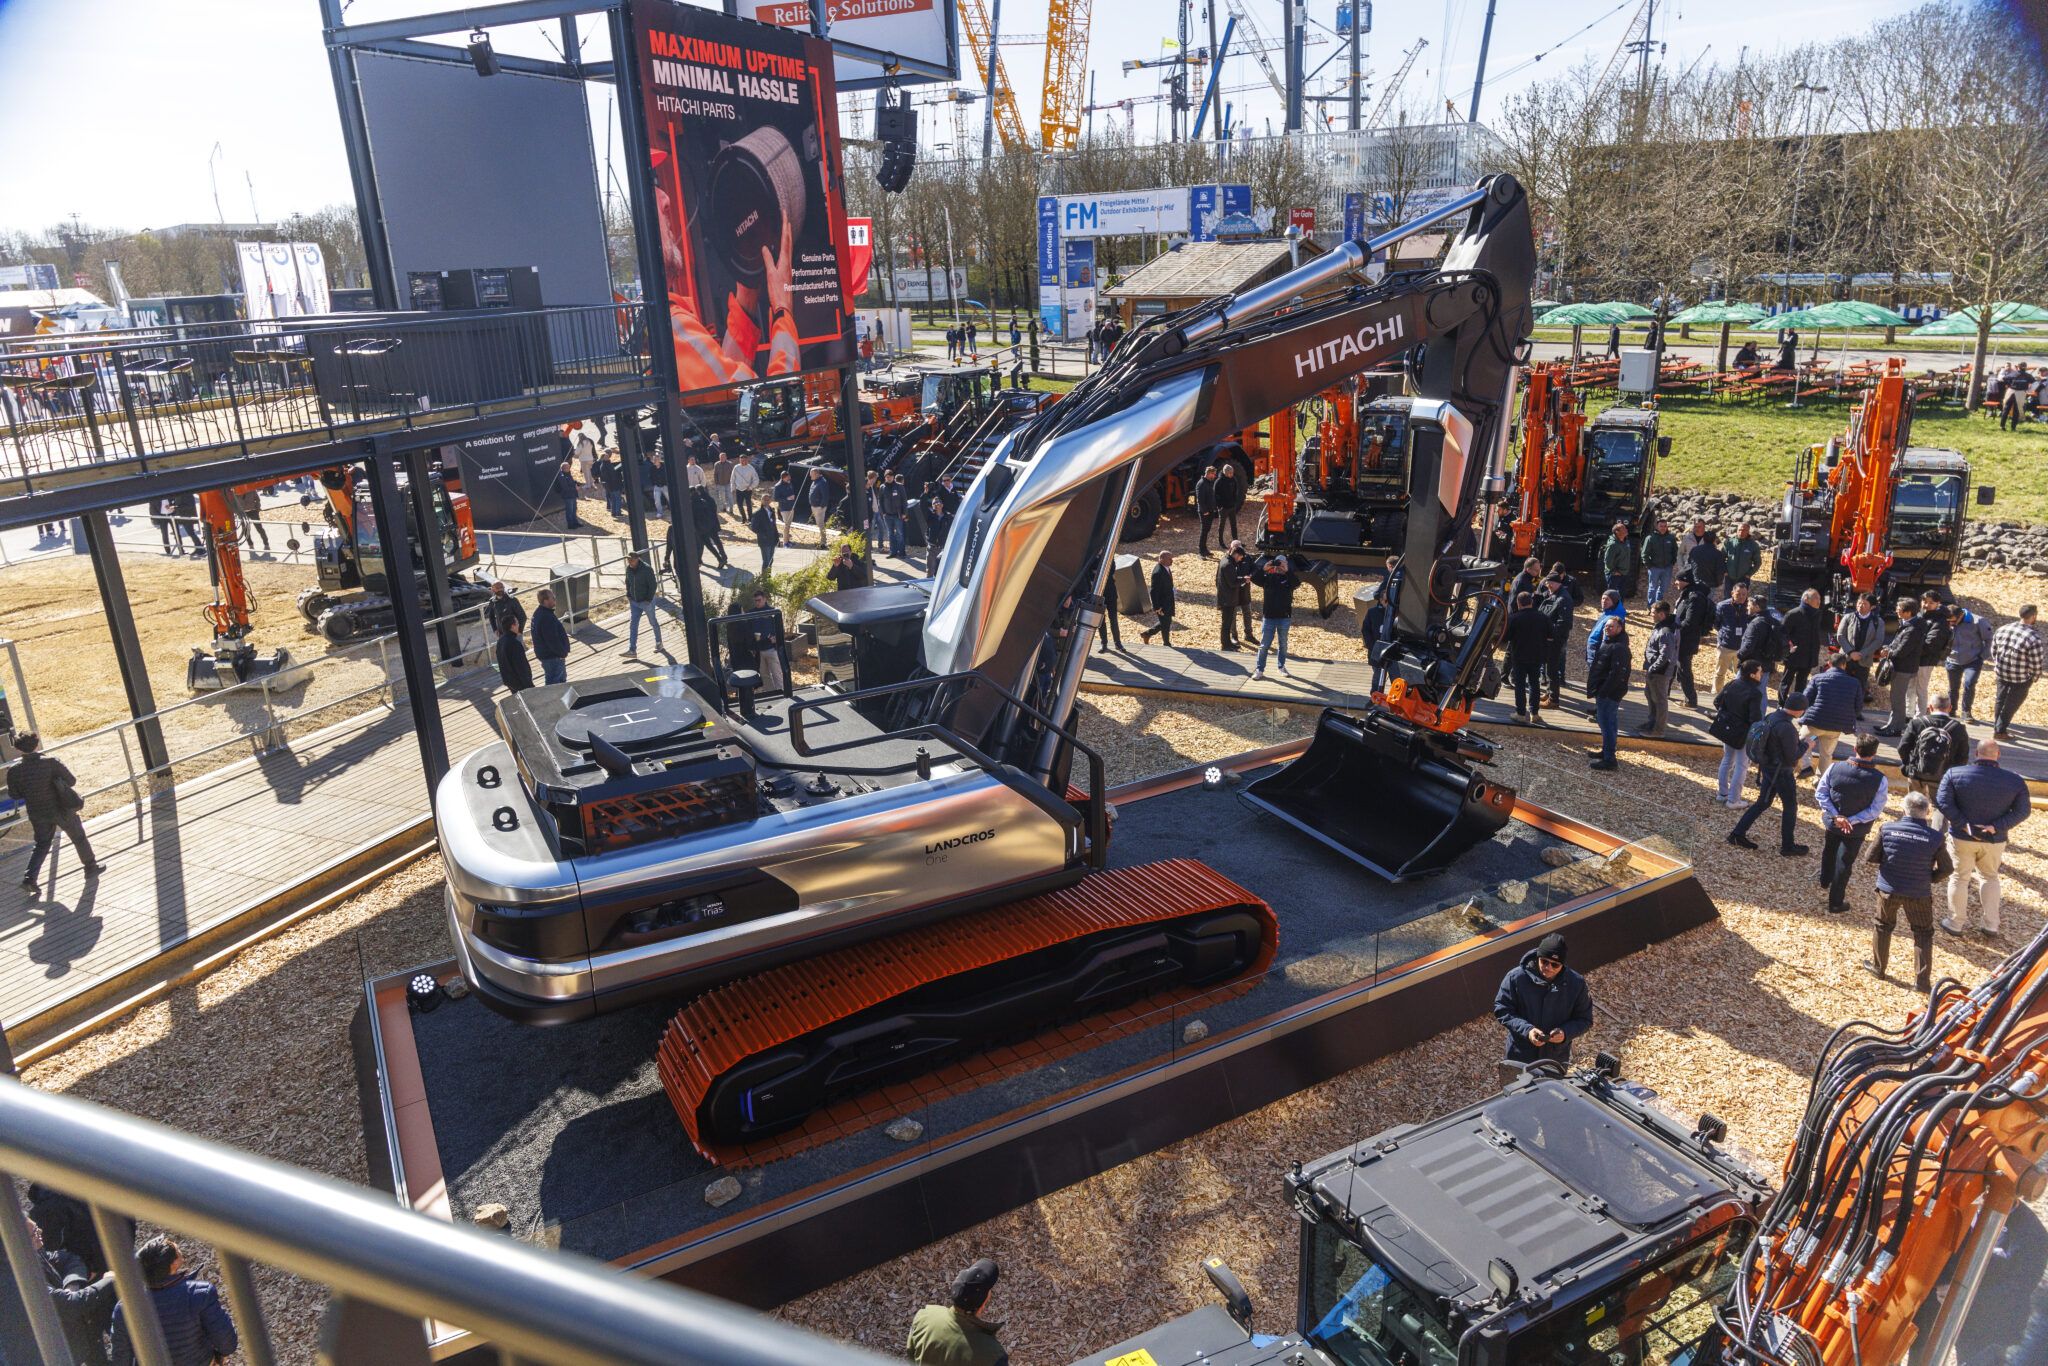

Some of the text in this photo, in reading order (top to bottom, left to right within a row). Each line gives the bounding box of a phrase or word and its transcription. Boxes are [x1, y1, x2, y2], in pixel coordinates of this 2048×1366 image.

[774, 0, 915, 24] Reliae Solutions
[649, 29, 806, 80] MAXIMUM UPTIME
[652, 59, 799, 104] MINIMAL HASSLE
[656, 95, 736, 120] HITACHI PARTS
[1065, 201, 1098, 230] FM
[1100, 207, 1121, 216] Outdoor
[1122, 206, 1149, 214] Exhibition
[1163, 203, 1175, 211] Mid
[735, 209, 759, 238] HITACHI
[241, 245, 258, 253] HKS
[265, 246, 280, 254] HKS
[1046, 222, 1054, 270] Scaffolding
[801, 253, 836, 263] Genuine Parts
[791, 266, 837, 277] Performance Parts
[783, 280, 838, 292] Remanufactured Parts
[804, 294, 839, 305] Selected Parts
[133, 310, 160, 328] HKS
[1294, 313, 1404, 378] HITACHI
[473, 436, 504, 447] solution
[504, 434, 516, 442] for
[880, 440, 903, 470] HITACHI
[965, 518, 982, 577] LANDCROS
[925, 828, 996, 855] LANDCROS
[925, 853, 948, 867] One
[702, 905, 724, 918] Trias
